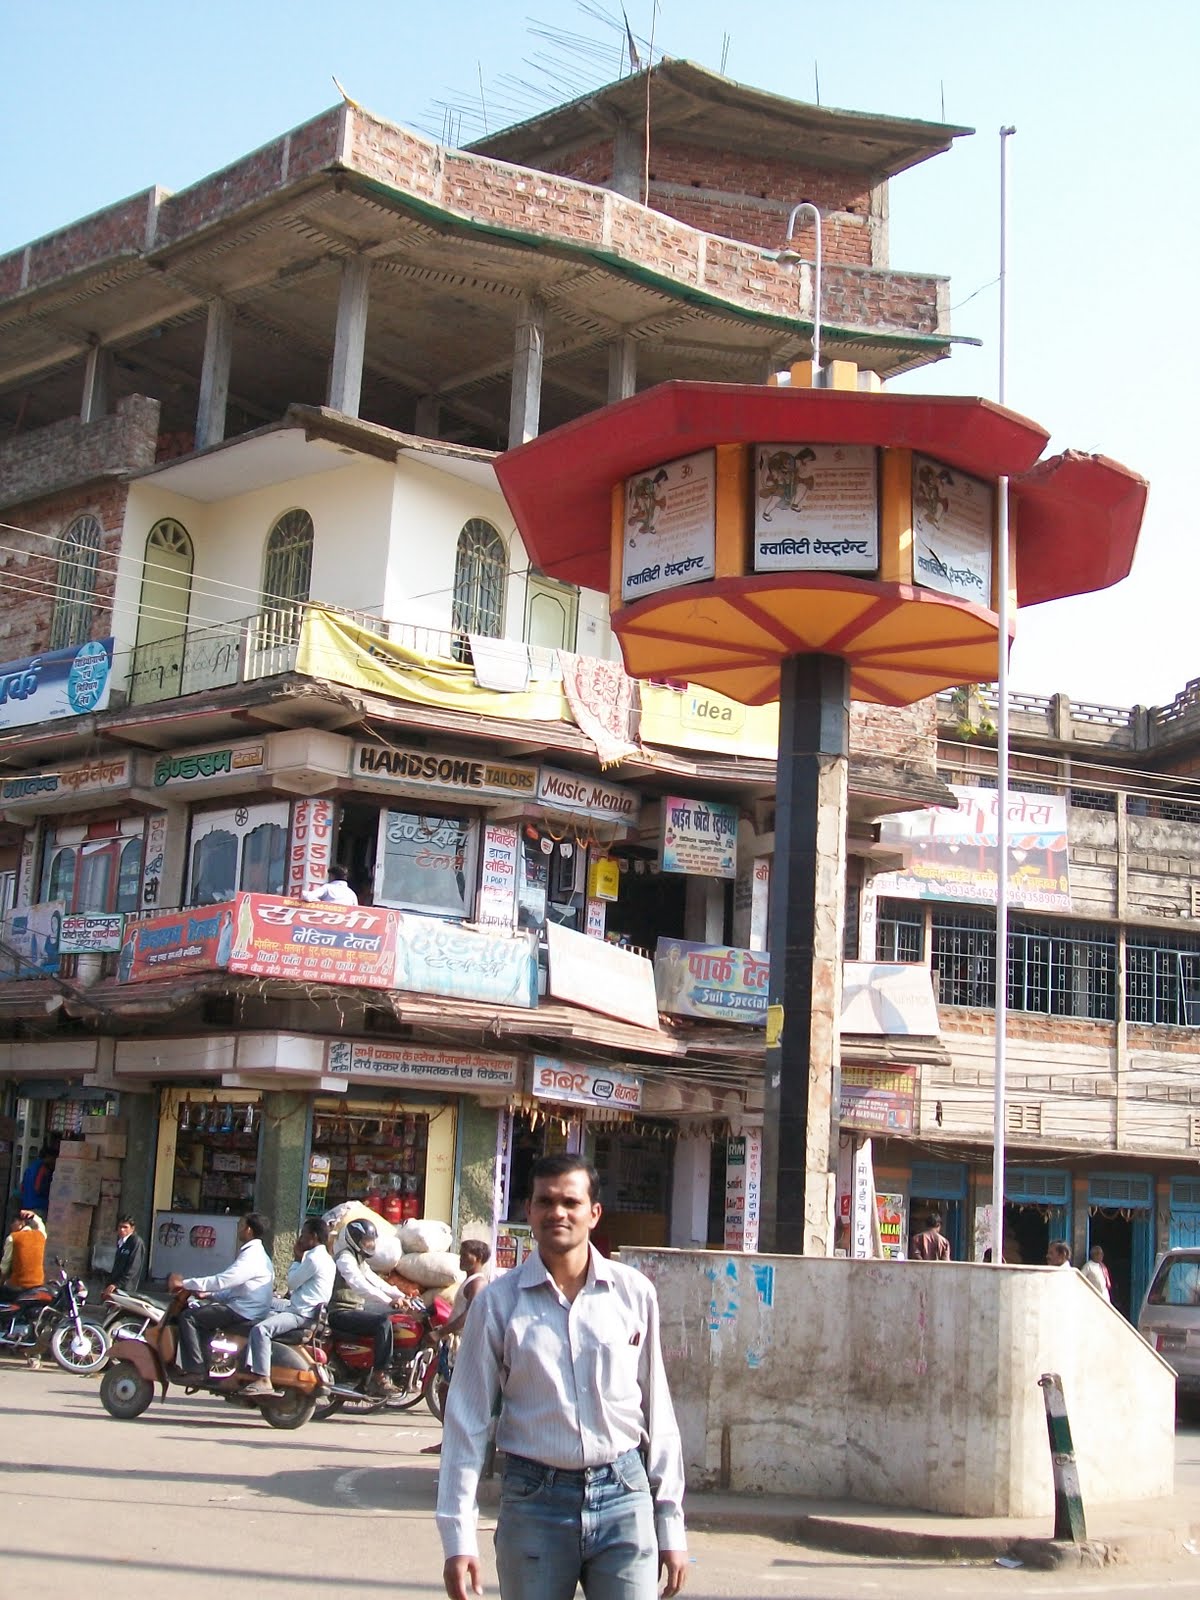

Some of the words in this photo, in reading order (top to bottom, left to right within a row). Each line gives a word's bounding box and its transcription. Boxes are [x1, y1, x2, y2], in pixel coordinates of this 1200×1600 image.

[759, 537, 811, 556] क्वालिटी
[626, 564, 661, 587] क्वालिटी
[359, 747, 485, 789] HANDSOME
[486, 770, 534, 788] TAILORS
[541, 775, 586, 803] Music
[485, 859, 514, 876] लोडिंग
[257, 903, 381, 930] सुरभी
[292, 927, 337, 946] लेडिज
[343, 932, 382, 951] टेलर्स
[687, 950, 736, 984] पार्क
[354, 1045, 373, 1058] सभी
[374, 1048, 401, 1062] प्रकार
